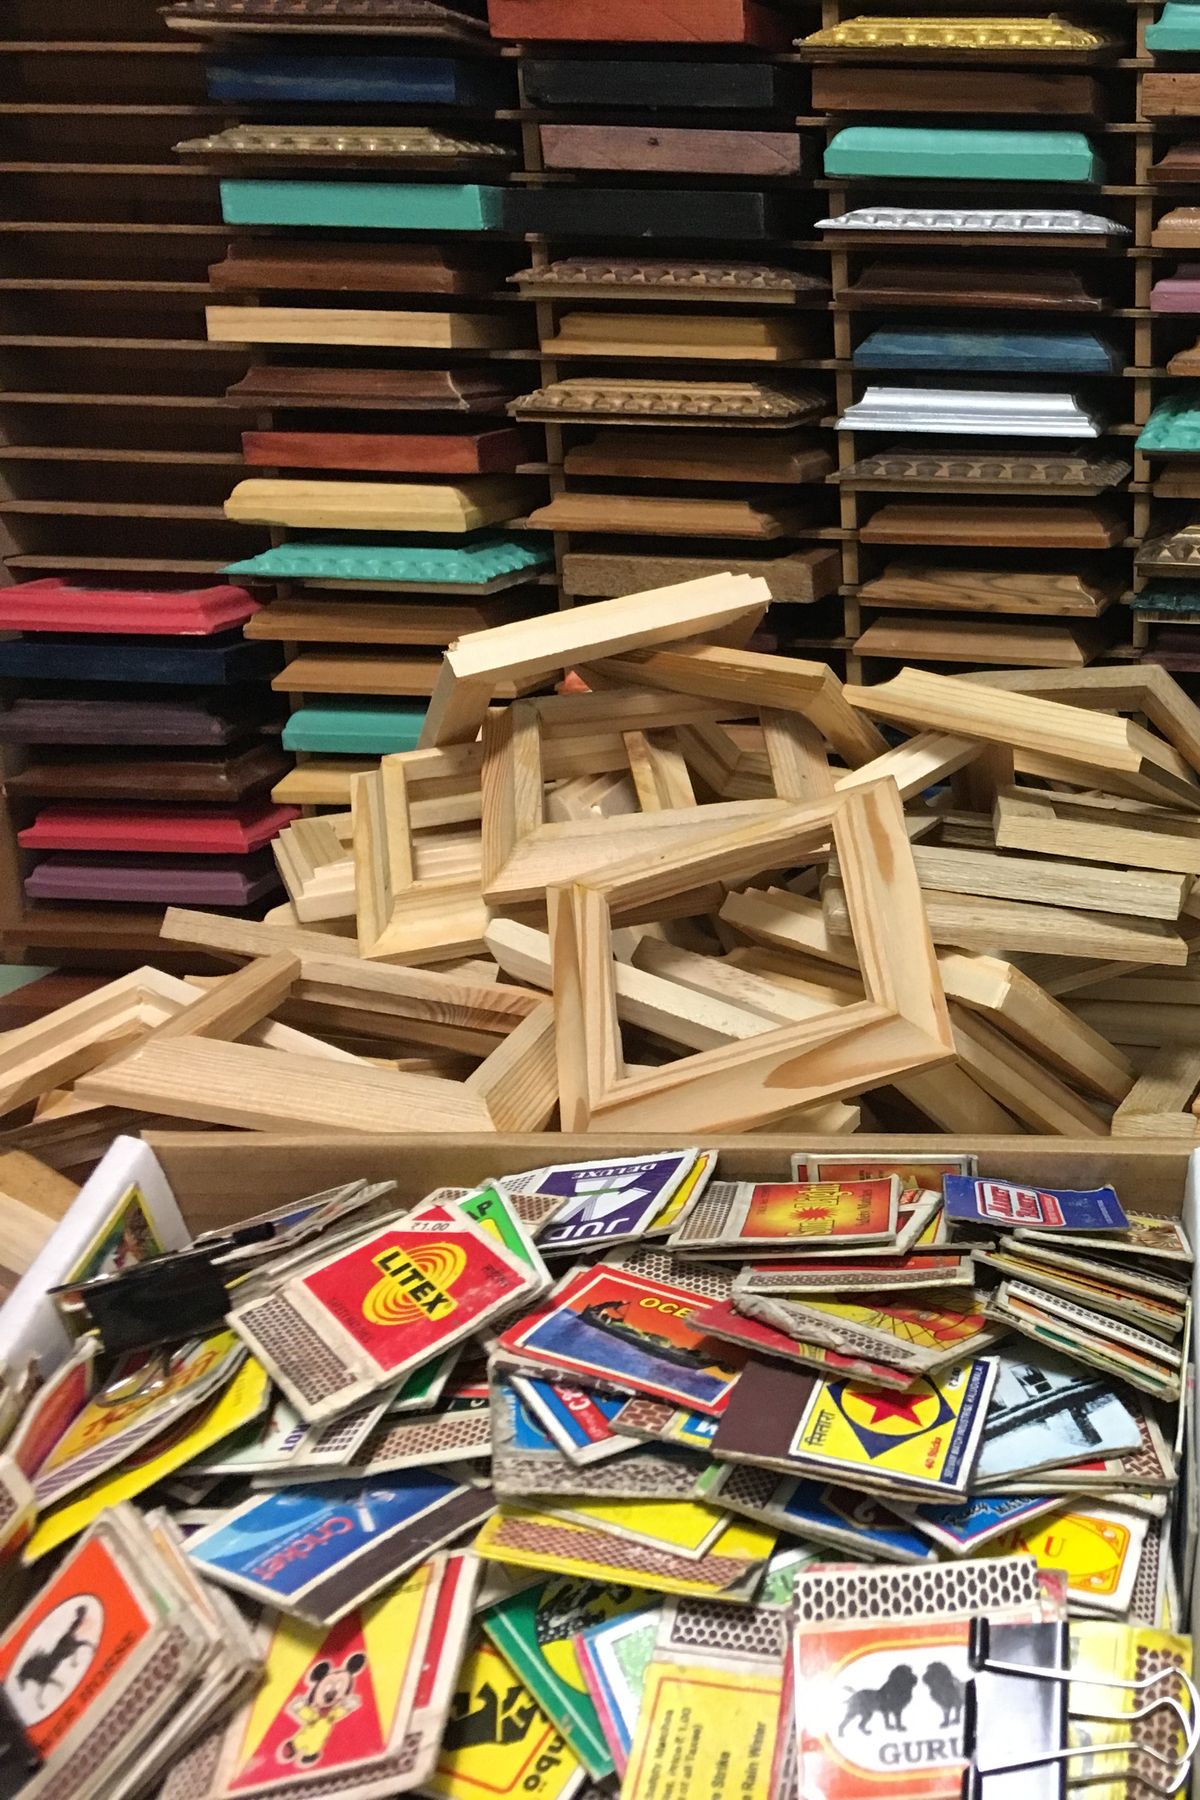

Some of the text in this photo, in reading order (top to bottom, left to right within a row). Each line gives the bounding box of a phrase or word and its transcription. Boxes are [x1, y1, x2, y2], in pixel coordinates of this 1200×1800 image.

[572, 1163, 657, 1180] DELUXE
[548, 1217, 630, 1241] JUD
[377, 1250, 450, 1315] LITEX
[638, 1296, 695, 1320] OCE
[804, 1408, 835, 1446] सितारा
[251, 1516, 355, 1581] Cricket
